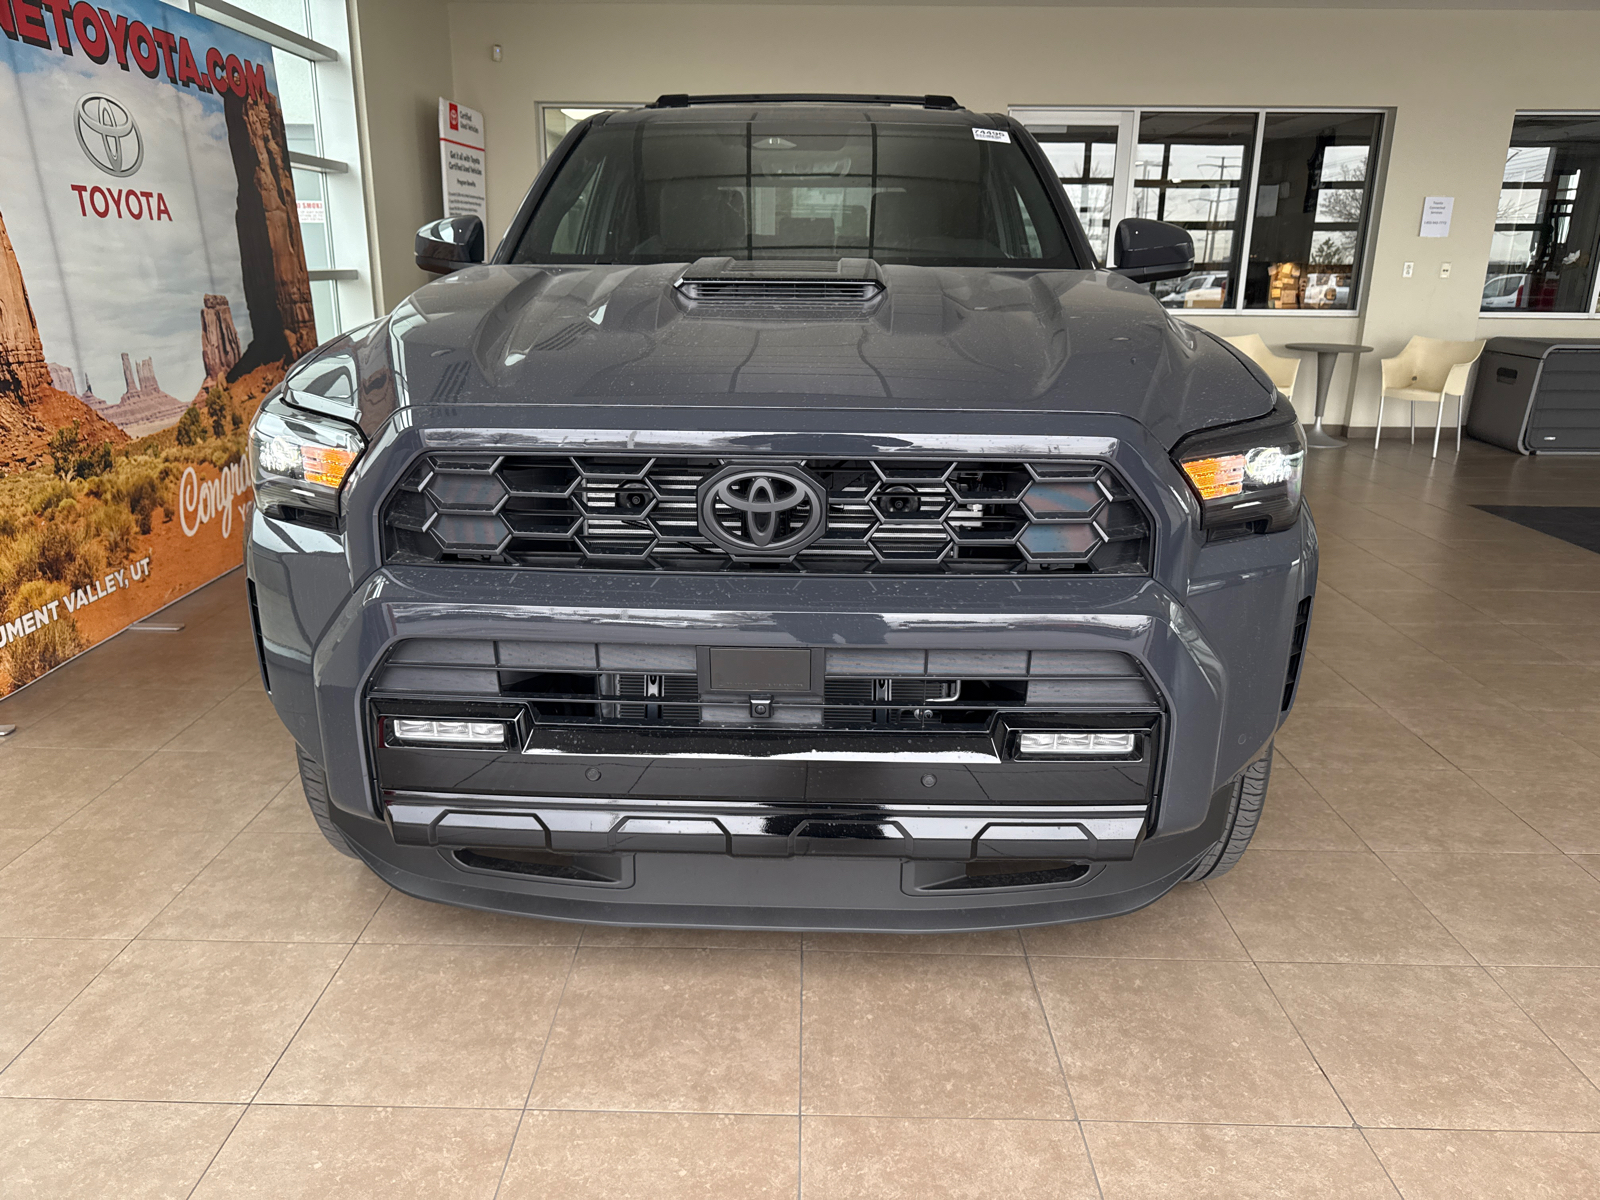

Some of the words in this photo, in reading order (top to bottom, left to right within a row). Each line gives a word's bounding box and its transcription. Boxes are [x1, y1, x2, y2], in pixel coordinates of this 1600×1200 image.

[71, 184, 173, 222] TOYOTA
[179, 446, 253, 539] Congra
[63, 568, 129, 613] VALLEY,
[130, 557, 150, 581] UT
